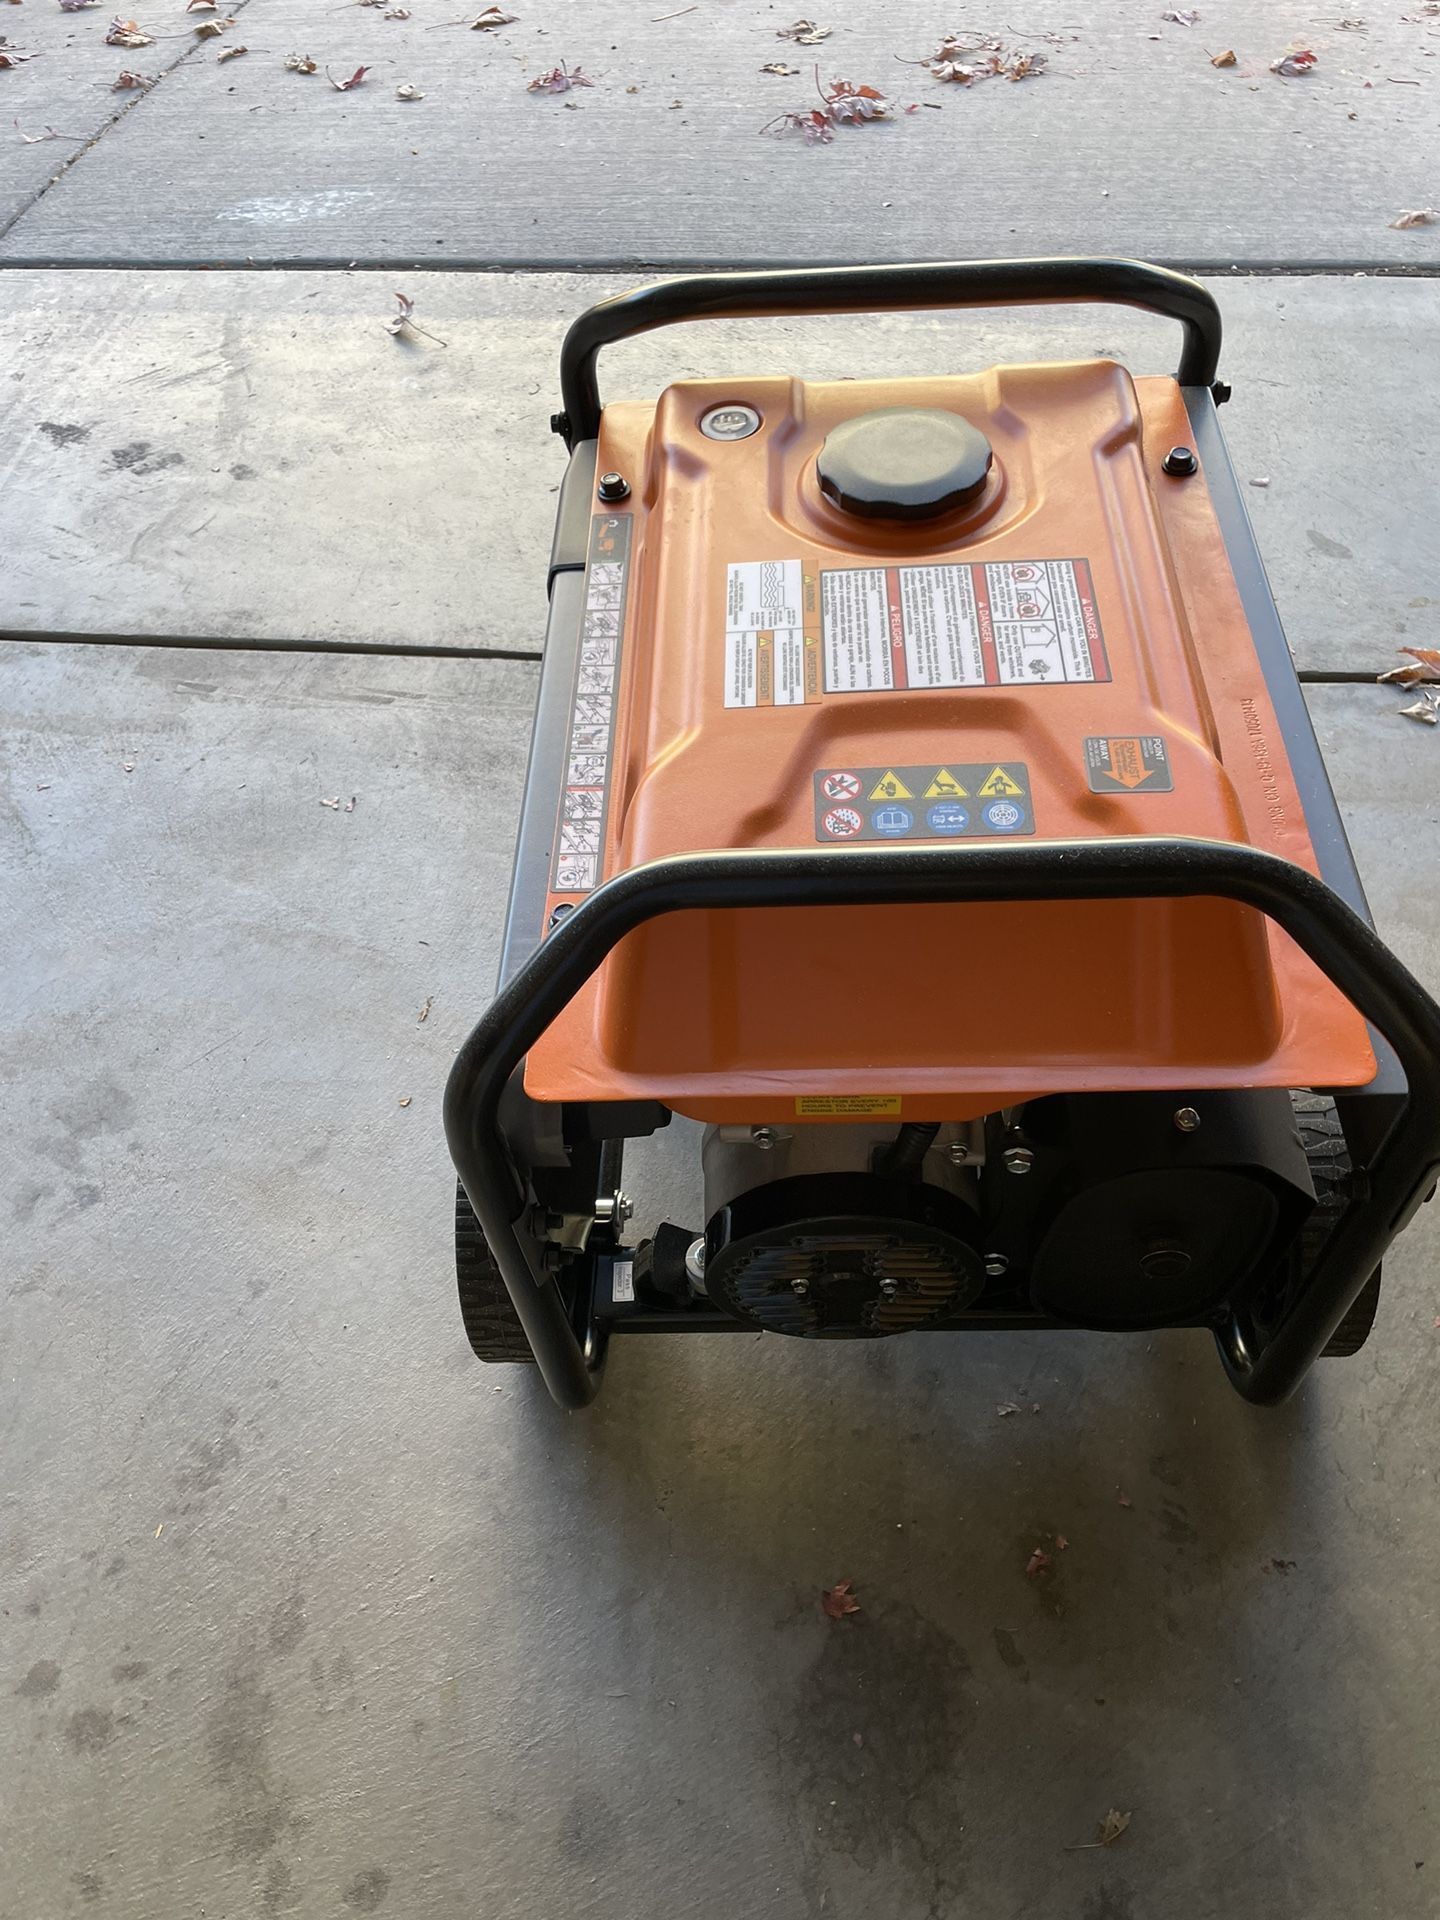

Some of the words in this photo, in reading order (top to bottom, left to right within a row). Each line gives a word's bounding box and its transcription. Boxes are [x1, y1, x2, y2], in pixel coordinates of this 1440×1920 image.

[891, 613, 902, 647] PELIGRO
[979, 610, 992, 643] DANGER
[1084, 606, 1097, 639] DANGER
[1099, 739, 1110, 761] AWAY
[1127, 741, 1140, 780] EXHAUST
[1153, 738, 1164, 761] POINT
